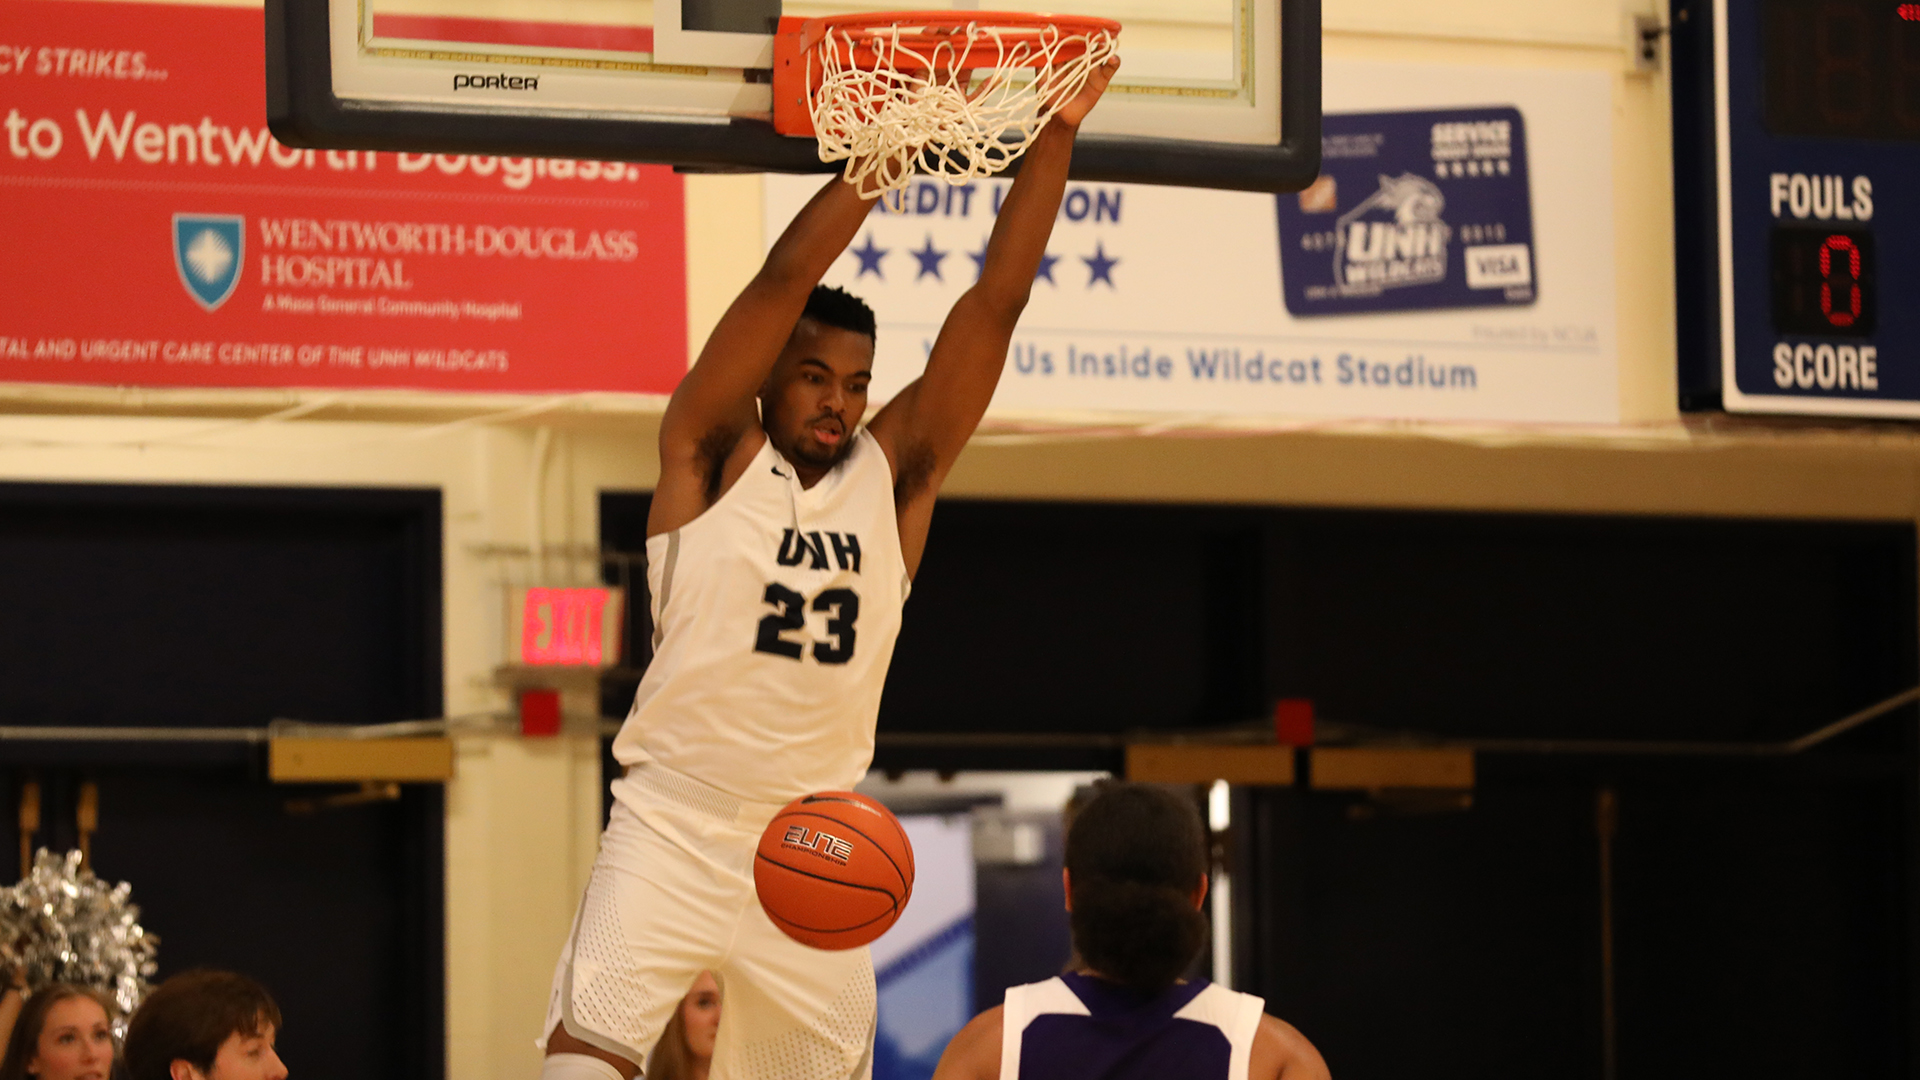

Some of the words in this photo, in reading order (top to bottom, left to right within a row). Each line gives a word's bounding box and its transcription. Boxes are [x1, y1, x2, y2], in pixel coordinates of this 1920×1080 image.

[35, 47, 168, 80] STRIKES...
[5, 109, 62, 159] to
[869, 182, 976, 217] EDIT
[1770, 173, 1873, 220] FOULS
[260, 217, 639, 262] WENTWORTH-DOUGLASS
[1347, 221, 1449, 263] UNH
[260, 254, 413, 290] HOSPITAL
[1477, 256, 1519, 276] VISA
[1819, 235, 1862, 327] 0
[377, 297, 459, 319] Community
[34, 337, 77, 362] AND
[80, 338, 159, 363] URGENT
[162, 340, 214, 365] CARE
[218, 341, 293, 367] CENTER
[297, 344, 325, 368] OF
[328, 345, 364, 369] THE
[366, 346, 411, 370] UNH
[413, 347, 509, 373] WILDCATS
[1014, 340, 1055, 376] Us
[1067, 342, 1174, 379] Inside
[1186, 347, 1324, 386] Wildcat
[1335, 352, 1479, 389] Stadium
[1773, 342, 1878, 390] SCORE
[776, 527, 862, 575] UNH
[522, 587, 611, 667] EXIT
[752, 579, 862, 667] 23
[780, 843, 847, 867] CHAMPIONSHIP
[782, 825, 854, 862] ELITE
